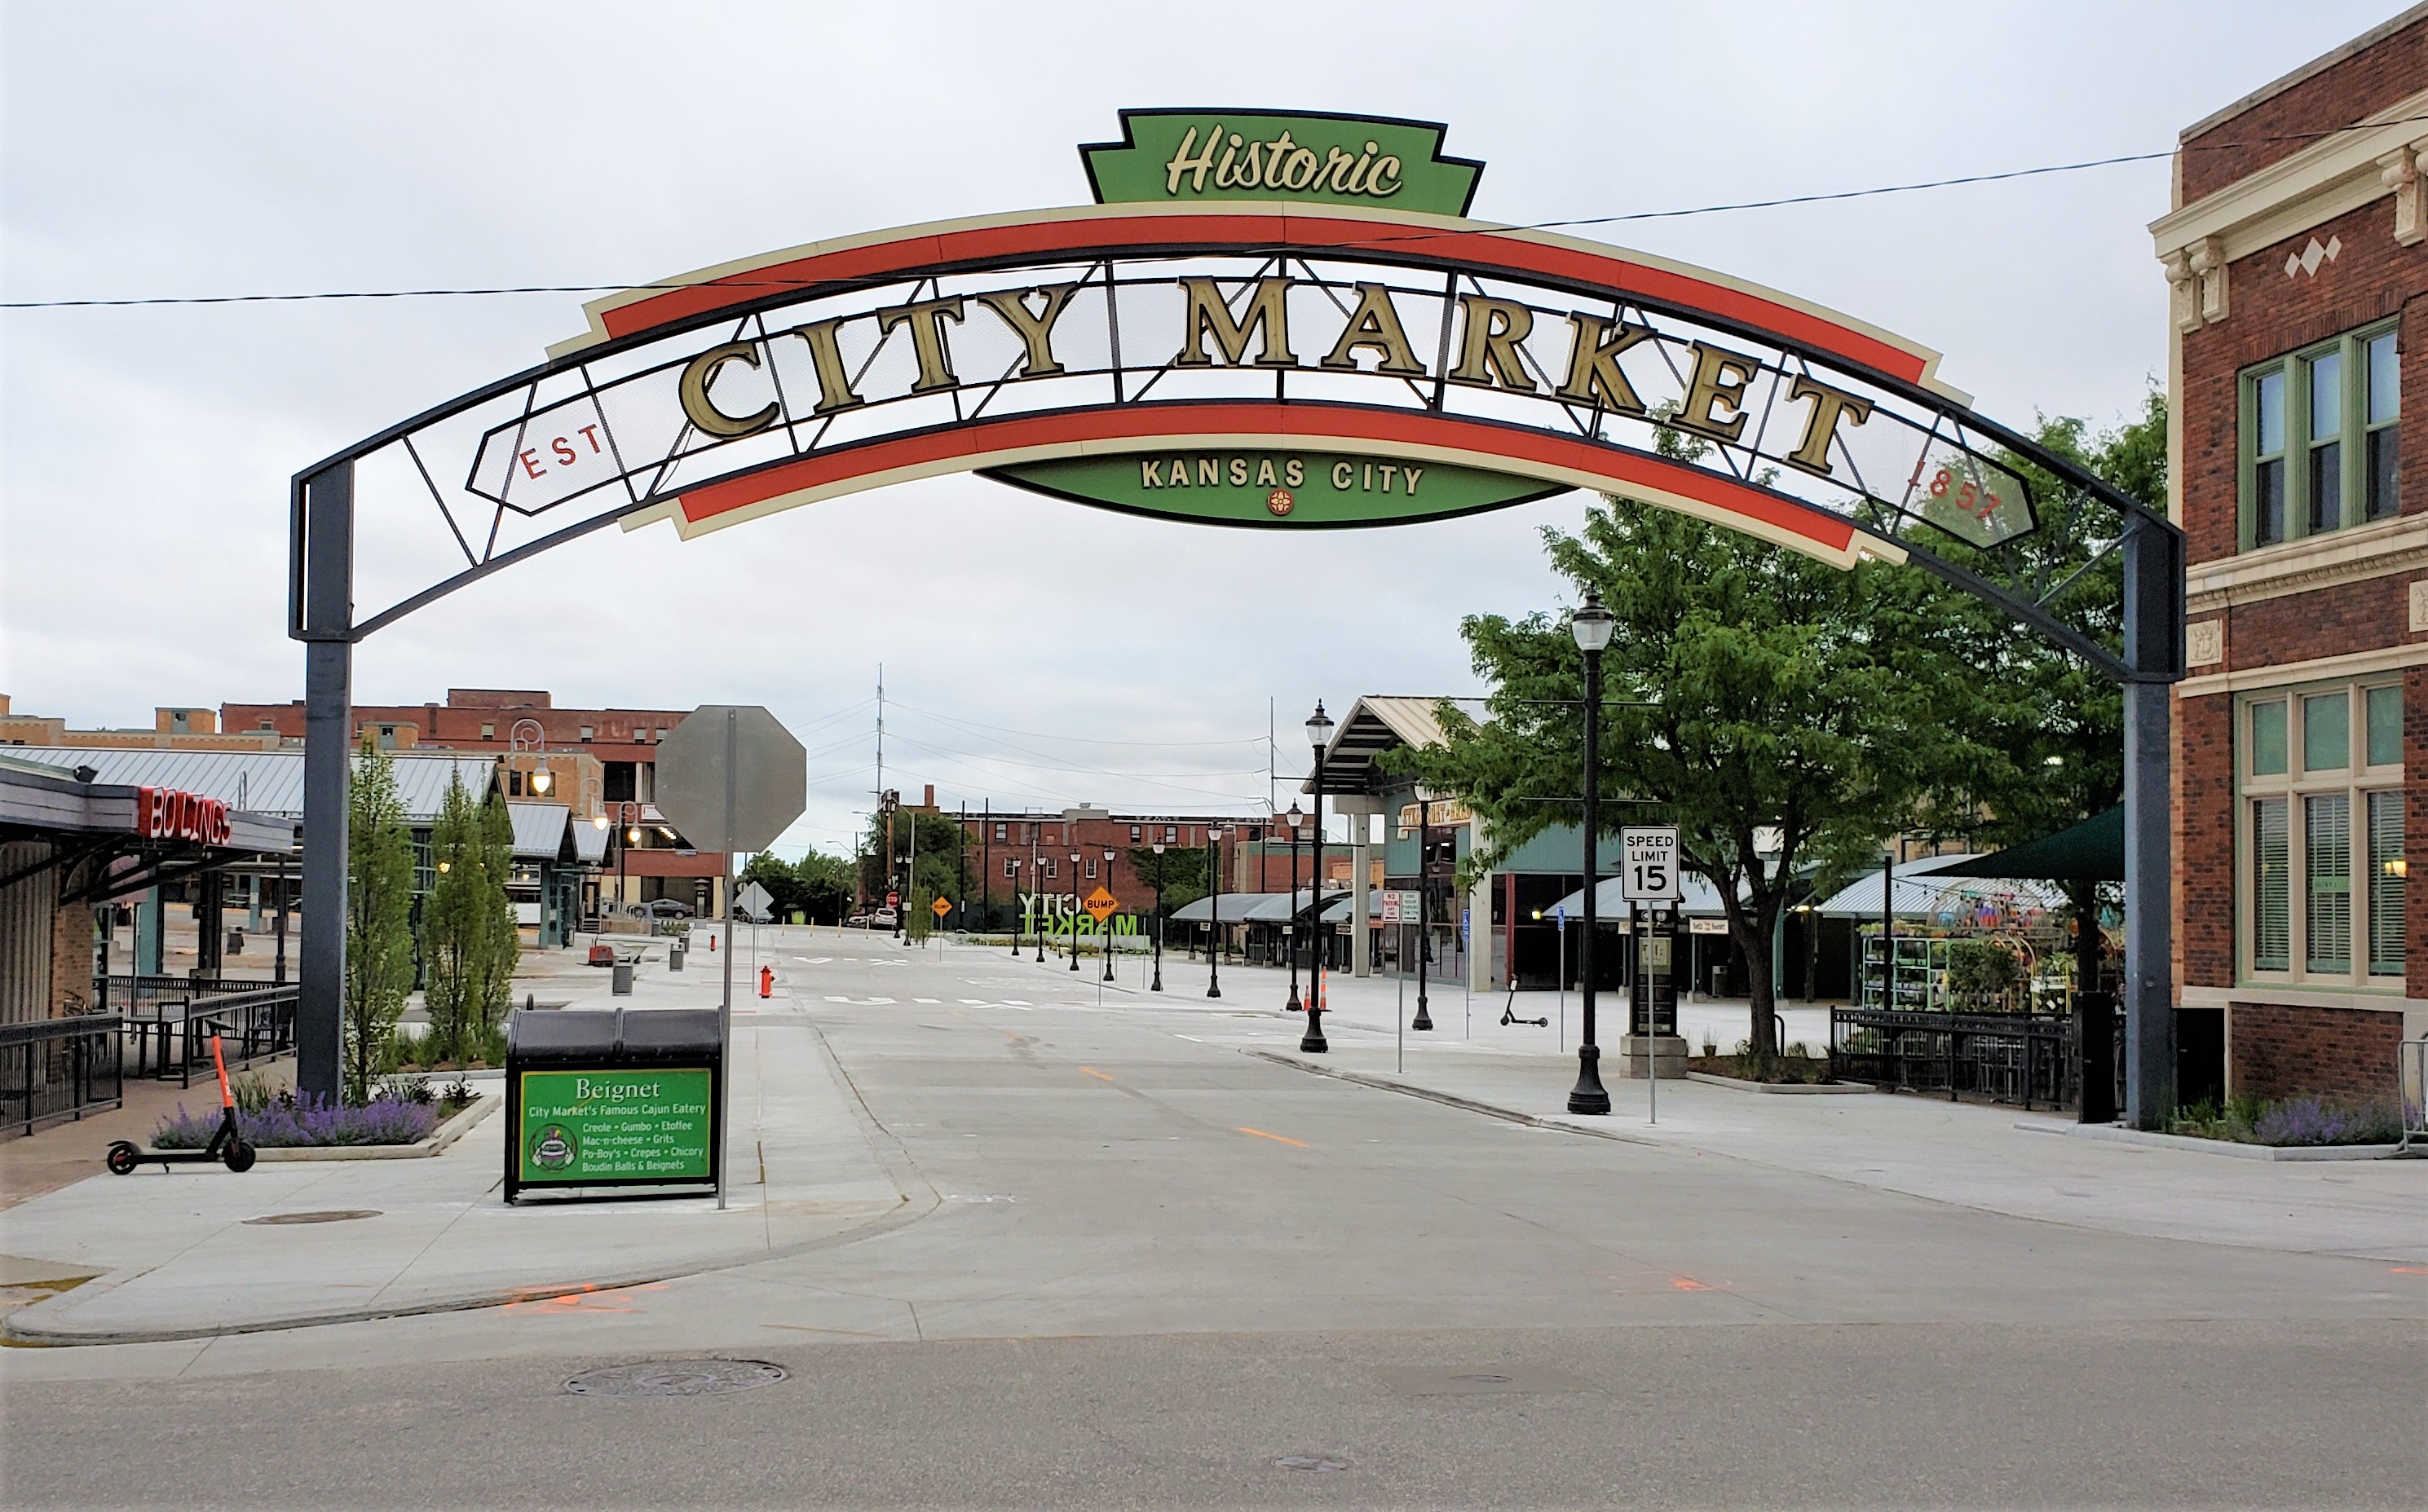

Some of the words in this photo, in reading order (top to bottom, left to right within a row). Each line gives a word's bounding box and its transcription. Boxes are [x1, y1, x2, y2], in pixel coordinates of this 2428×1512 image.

[1166, 123, 1402, 196] Historic
[678, 280, 1078, 440] CITY
[1176, 275, 1874, 476] MARKET
[520, 424, 601, 479] EST
[1141, 458, 1304, 487] KANSAS
[1332, 461, 1424, 496] CITY
[1627, 836, 1673, 847] SPEED
[1631, 851, 1668, 862] LIMIT
[1634, 866, 1666, 891] 15
[1087, 900, 1115, 909] BUMP
[576, 1078, 660, 1103] Beignet
[529, 1107, 550, 1118] City
[553, 1105, 597, 1117] Market's
[600, 1104, 638, 1115] Famous
[642, 1104, 669, 1117] Cajun
[673, 1103, 706, 1115] Eatery
[583, 1123, 611, 1132] Creole
[621, 1122, 651, 1131] Gumbo
[661, 1120, 693, 1131] Etoffee
[583, 1135, 643, 1145] Mac-n-cheese
[653, 1134, 674, 1144] Grits
[583, 1148, 620, 1160] Po-Boy's
[630, 1148, 660, 1158] Crepes
[670, 1147, 704, 1157] Chicory
[583, 1162, 611, 1171] Boudin
[615, 1161, 635, 1170] Balls
[638, 1161, 644, 1170] &
[647, 1159, 685, 1171] Beignets
